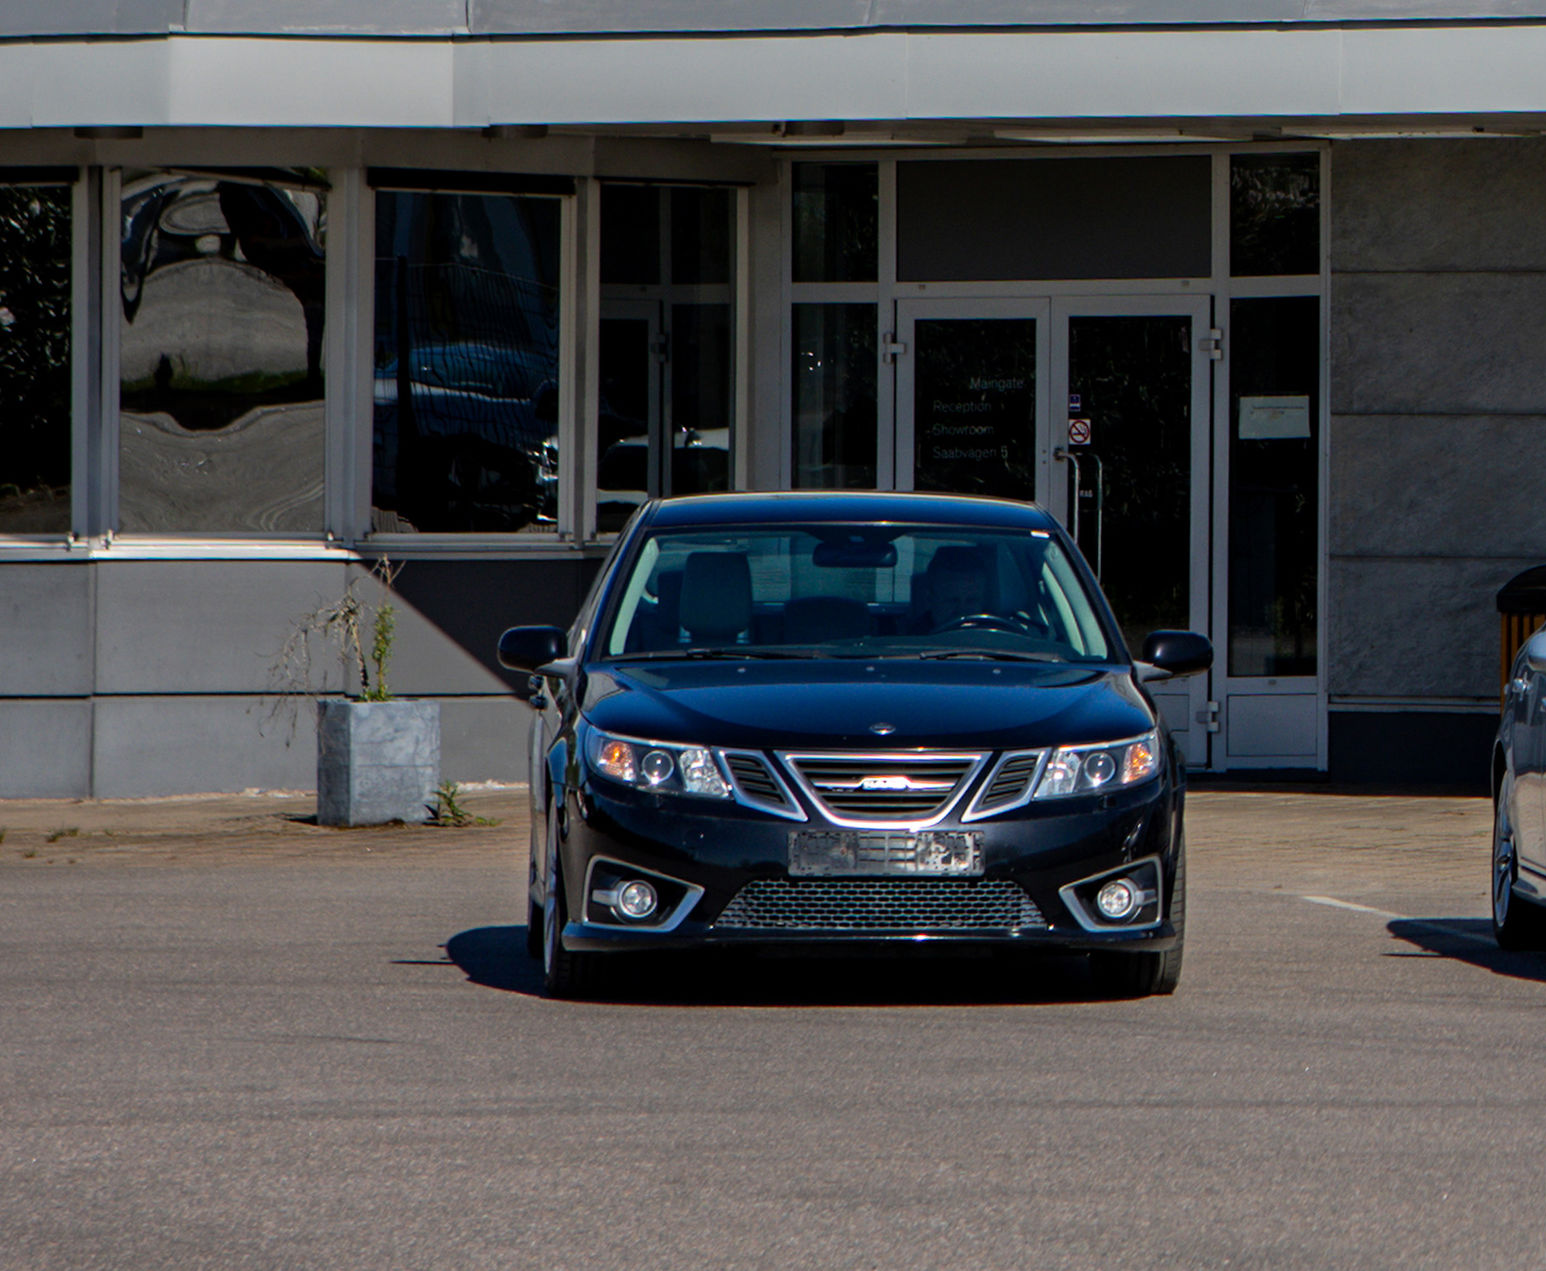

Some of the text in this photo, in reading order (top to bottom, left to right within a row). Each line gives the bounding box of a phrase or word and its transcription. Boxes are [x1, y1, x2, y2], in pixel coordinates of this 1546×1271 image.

[968, 376, 1024, 392] Maingate
[932, 400, 992, 414] Reception
[932, 422, 994, 436] Showroom
[1000, 445, 1009, 459] 5
